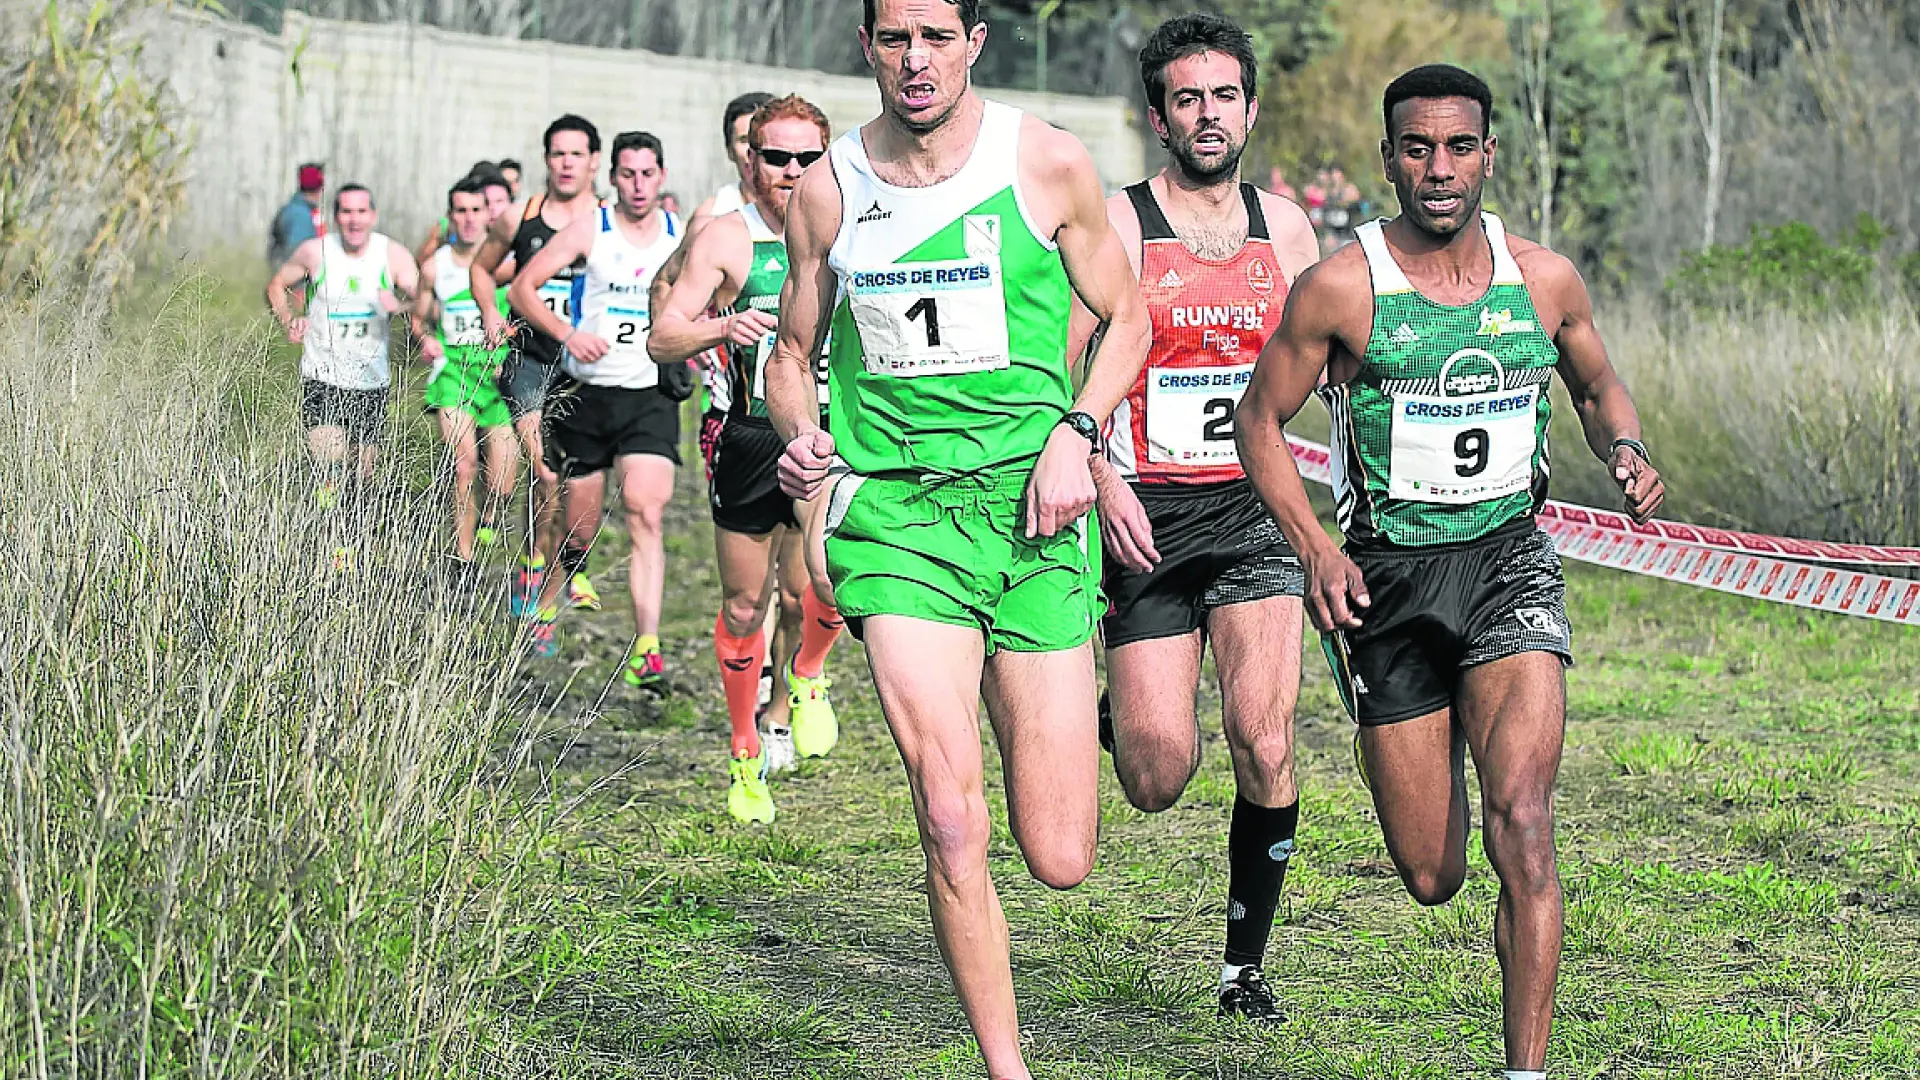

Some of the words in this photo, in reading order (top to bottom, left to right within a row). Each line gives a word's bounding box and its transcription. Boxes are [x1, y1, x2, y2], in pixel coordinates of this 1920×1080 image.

[854, 271, 907, 288] CROSS
[911, 269, 932, 284] DE
[936, 265, 990, 284] REYES
[904, 297, 940, 347] 1
[1159, 374, 1210, 387] CROSS
[1212, 373, 1232, 386] DE
[1203, 397, 1236, 441] 2
[1405, 401, 1463, 418] CROSS
[1466, 401, 1485, 417] DE
[1488, 394, 1532, 413] REYES
[1453, 427, 1491, 478] 9
